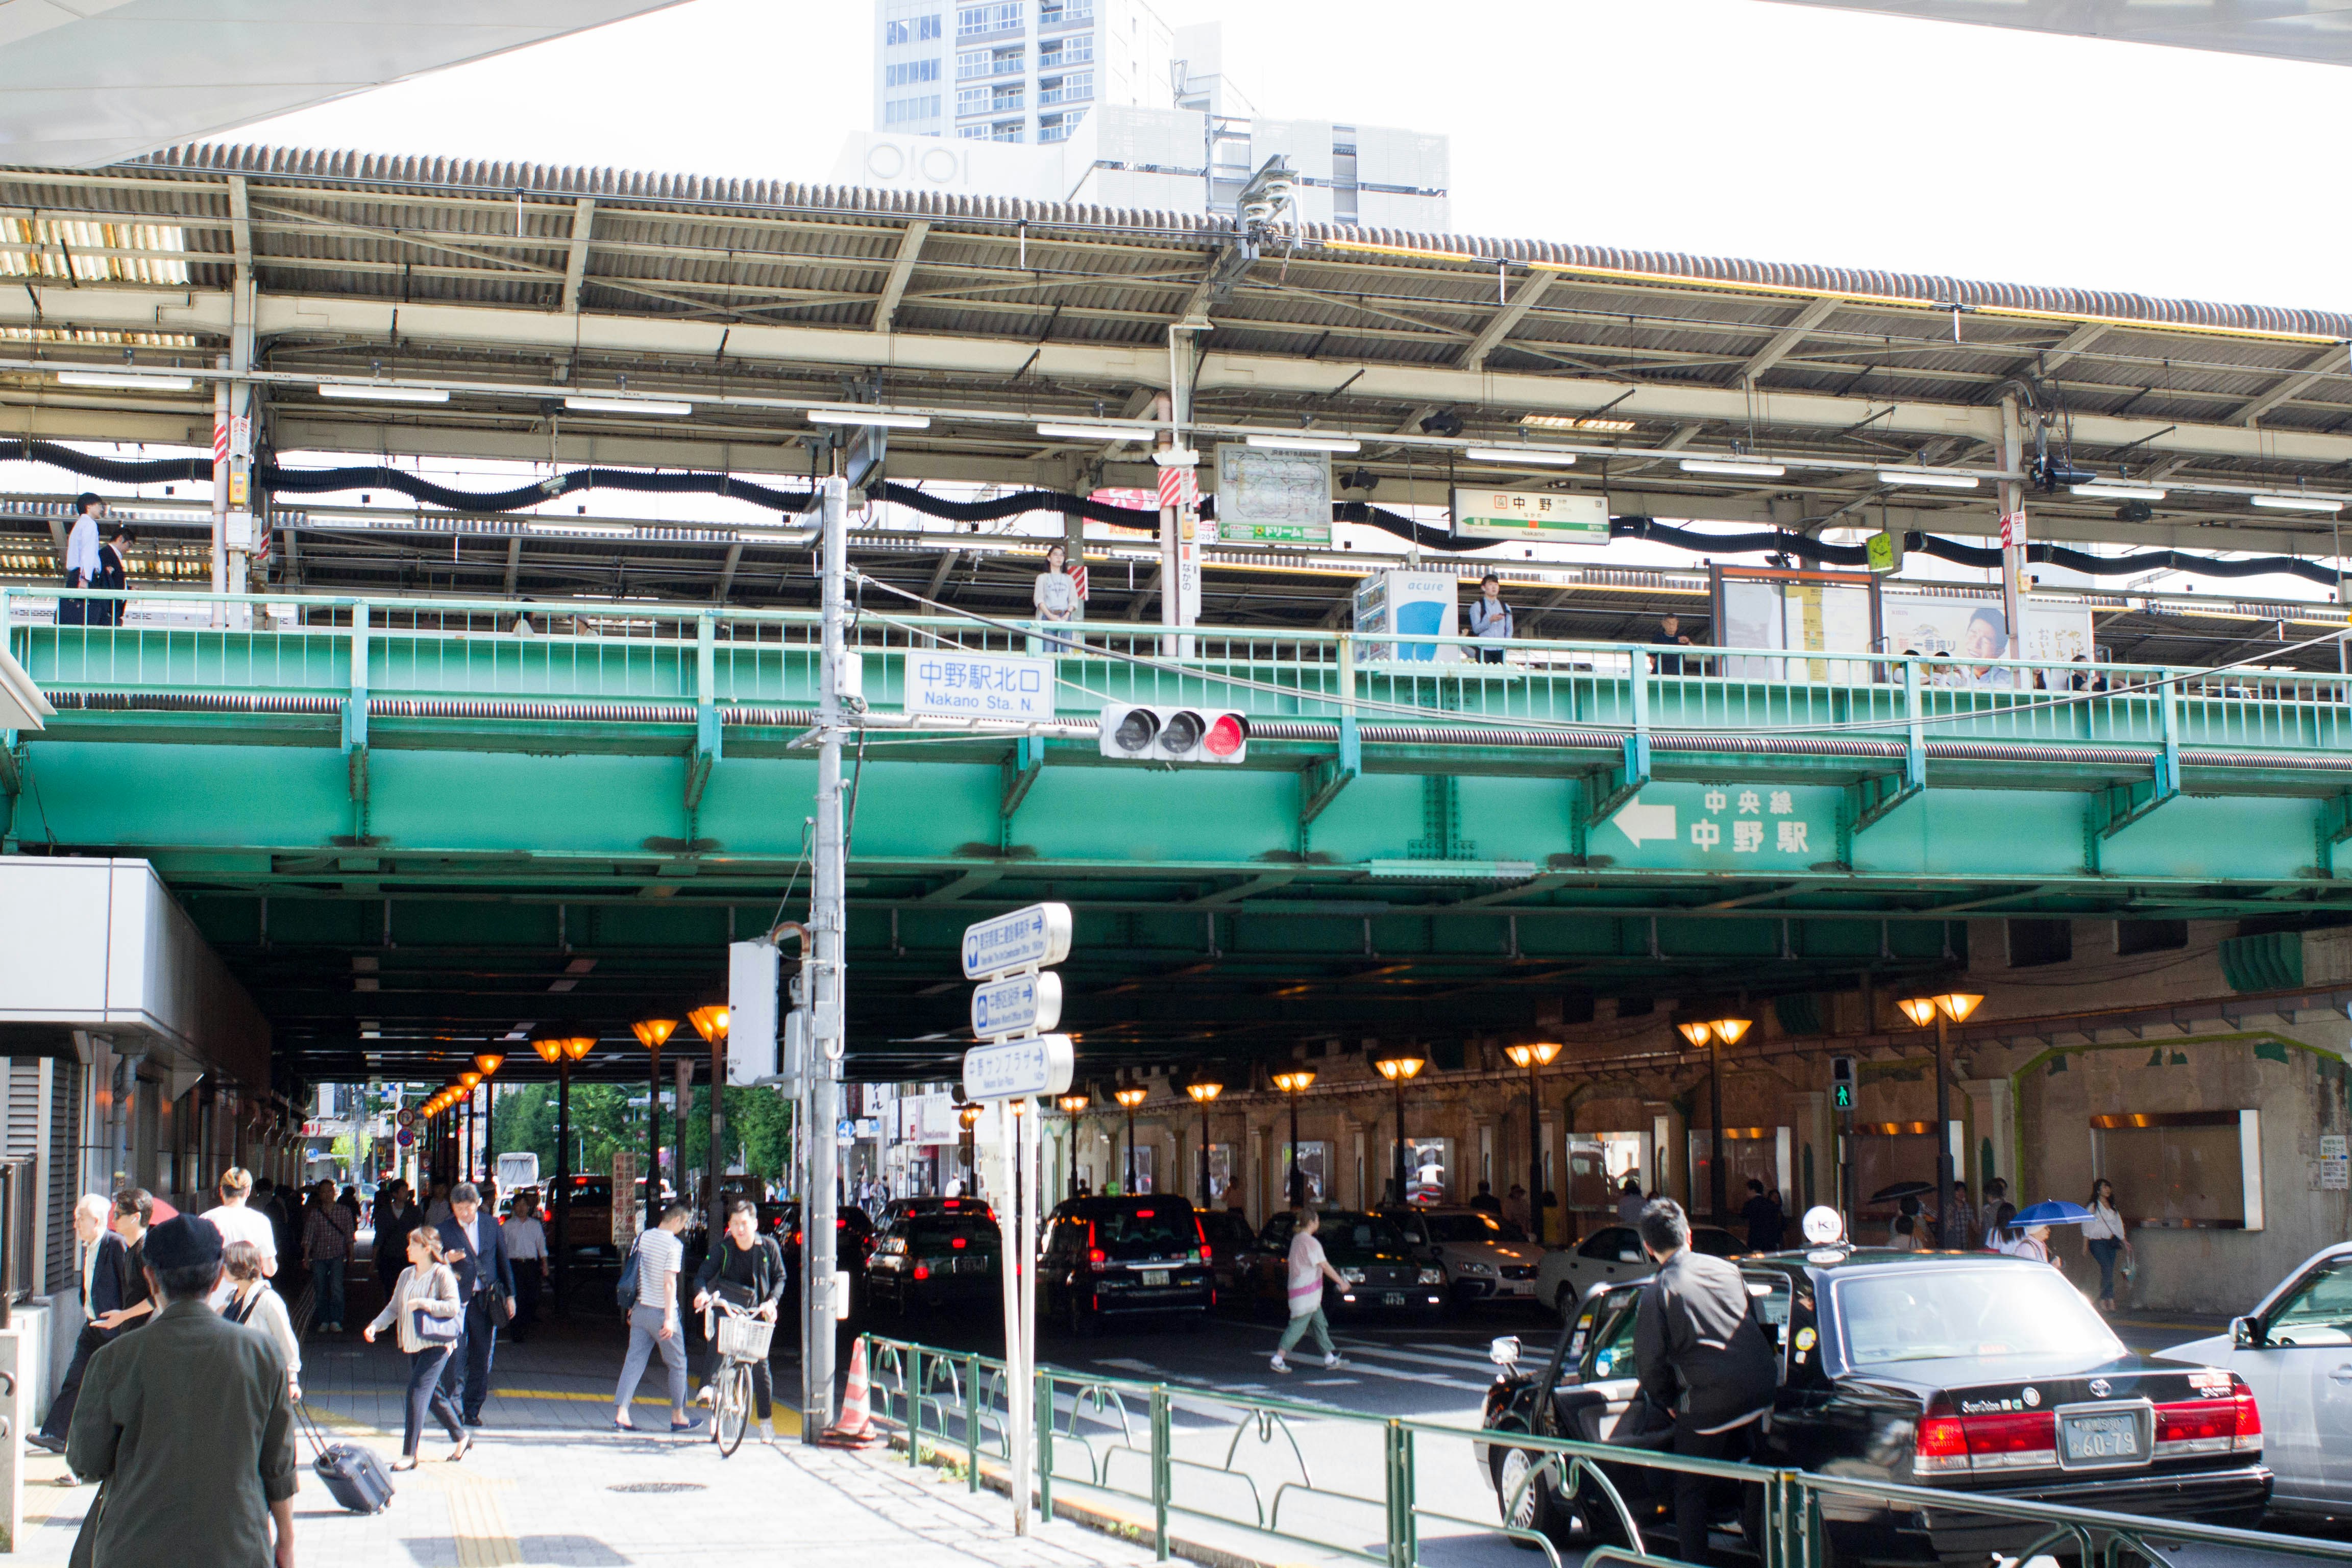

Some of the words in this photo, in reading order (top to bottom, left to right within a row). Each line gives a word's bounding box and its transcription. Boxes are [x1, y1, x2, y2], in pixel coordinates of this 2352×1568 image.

[1513, 496, 1552, 511] 中野
[1265, 526, 1301, 537] ドリーム
[1182, 564, 1191, 591] なかの
[1408, 581, 1444, 591] acure
[920, 660, 1039, 693] 中野駅北口
[925, 691, 979, 708] Nakano
[987, 695, 1014, 709] Sta.
[1021, 698, 1034, 712] N.
[1704, 790, 1793, 815] 中央線
[1690, 818, 1809, 853] 中野駅
[2082, 1432, 2139, 1457] 60-79
